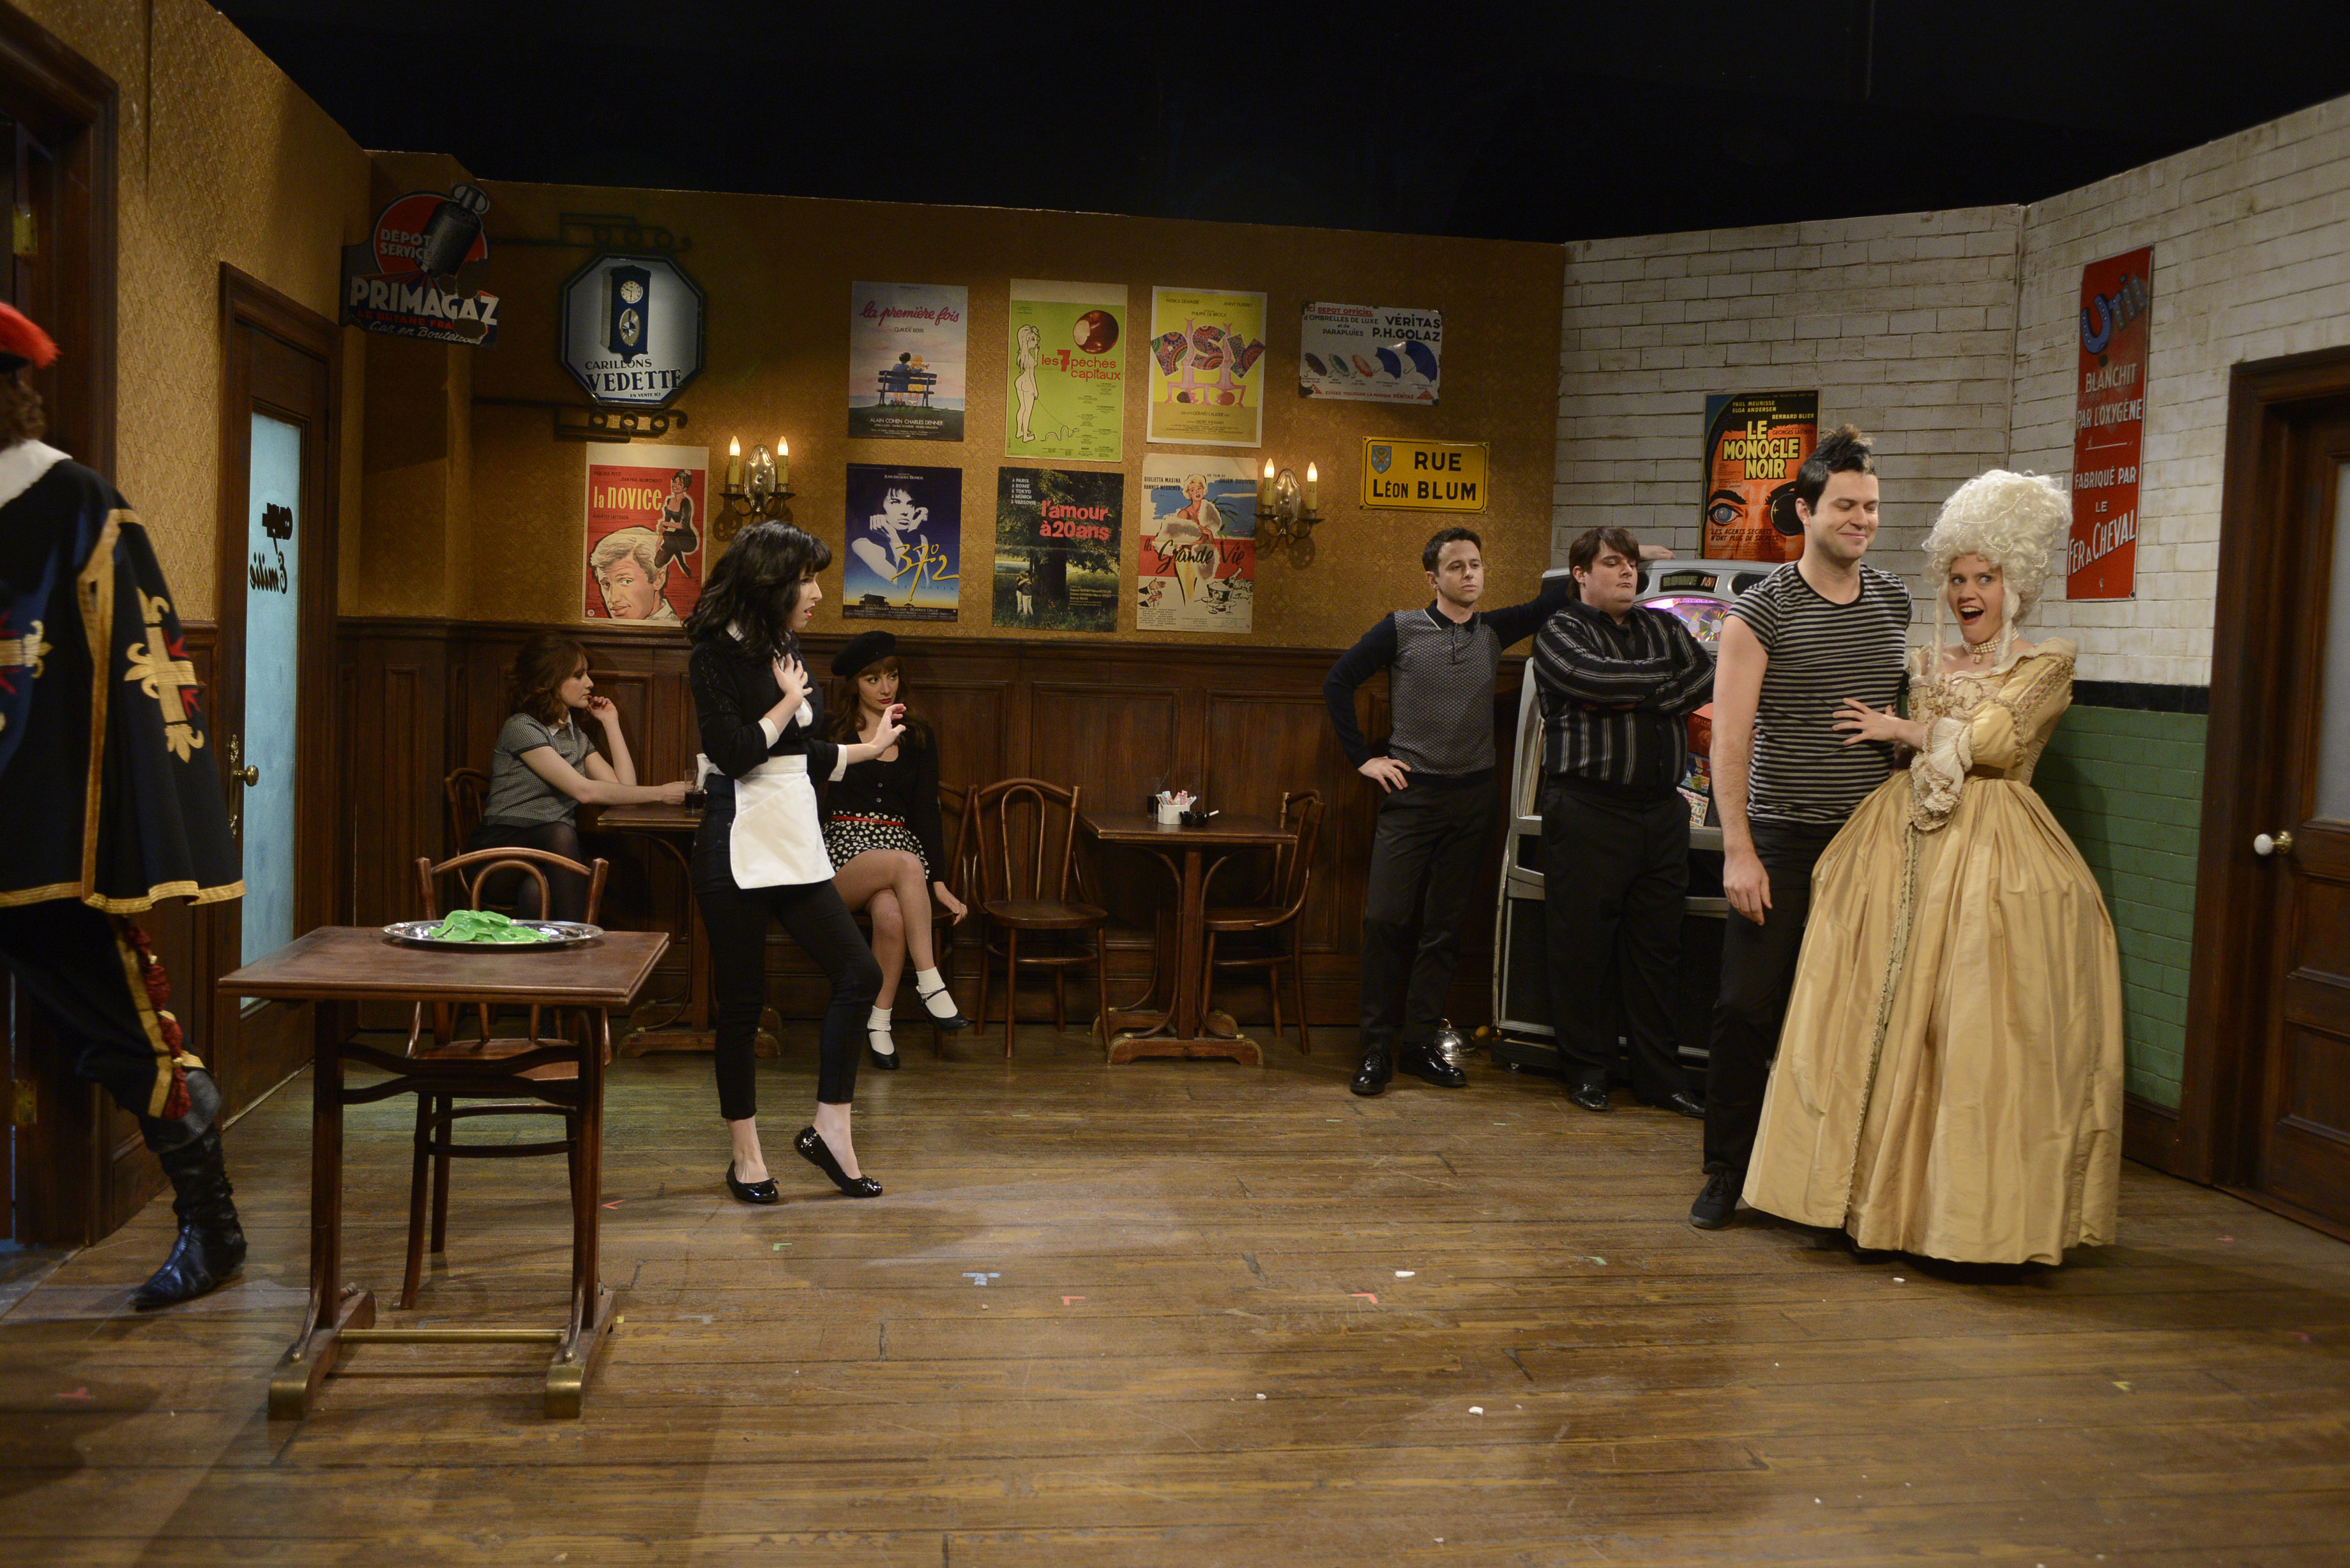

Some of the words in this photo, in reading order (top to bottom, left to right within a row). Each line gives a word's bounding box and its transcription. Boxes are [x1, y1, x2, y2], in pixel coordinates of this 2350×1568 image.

[381, 242, 430, 260] SERVICE
[351, 276, 499, 326] PRIMAGAZ
[377, 312, 426, 327] BUTANE
[878, 306, 935, 326] première
[934, 306, 960, 326] fois
[1042, 354, 1059, 366] les
[1057, 349, 1072, 372] 7
[1071, 357, 1117, 370] péchés
[1150, 325, 1266, 380] PSY
[585, 359, 652, 370] CARILLONS
[586, 368, 682, 393] VEDETTE
[1071, 370, 1121, 382] capitaux
[2085, 363, 2137, 393] BLANCHIT
[2077, 409, 2092, 429] PAR
[1747, 420, 1768, 441] LE
[1723, 439, 1800, 460] MONOCLE
[1414, 451, 1461, 472] RUE
[1745, 459, 1785, 479] NOIR
[2075, 465, 2115, 490] FABRIQUÉ
[2118, 466, 2137, 485] PAR
[594, 486, 605, 509] la
[1417, 481, 1476, 501] BLUM
[1042, 500, 1109, 521] l'amour
[2095, 501, 2108, 513] LE
[2068, 538, 2085, 577] FER
[2093, 509, 2135, 560] CHEVAL
[1156, 539, 1213, 574] Grande
[1220, 541, 1245, 565] Vie
